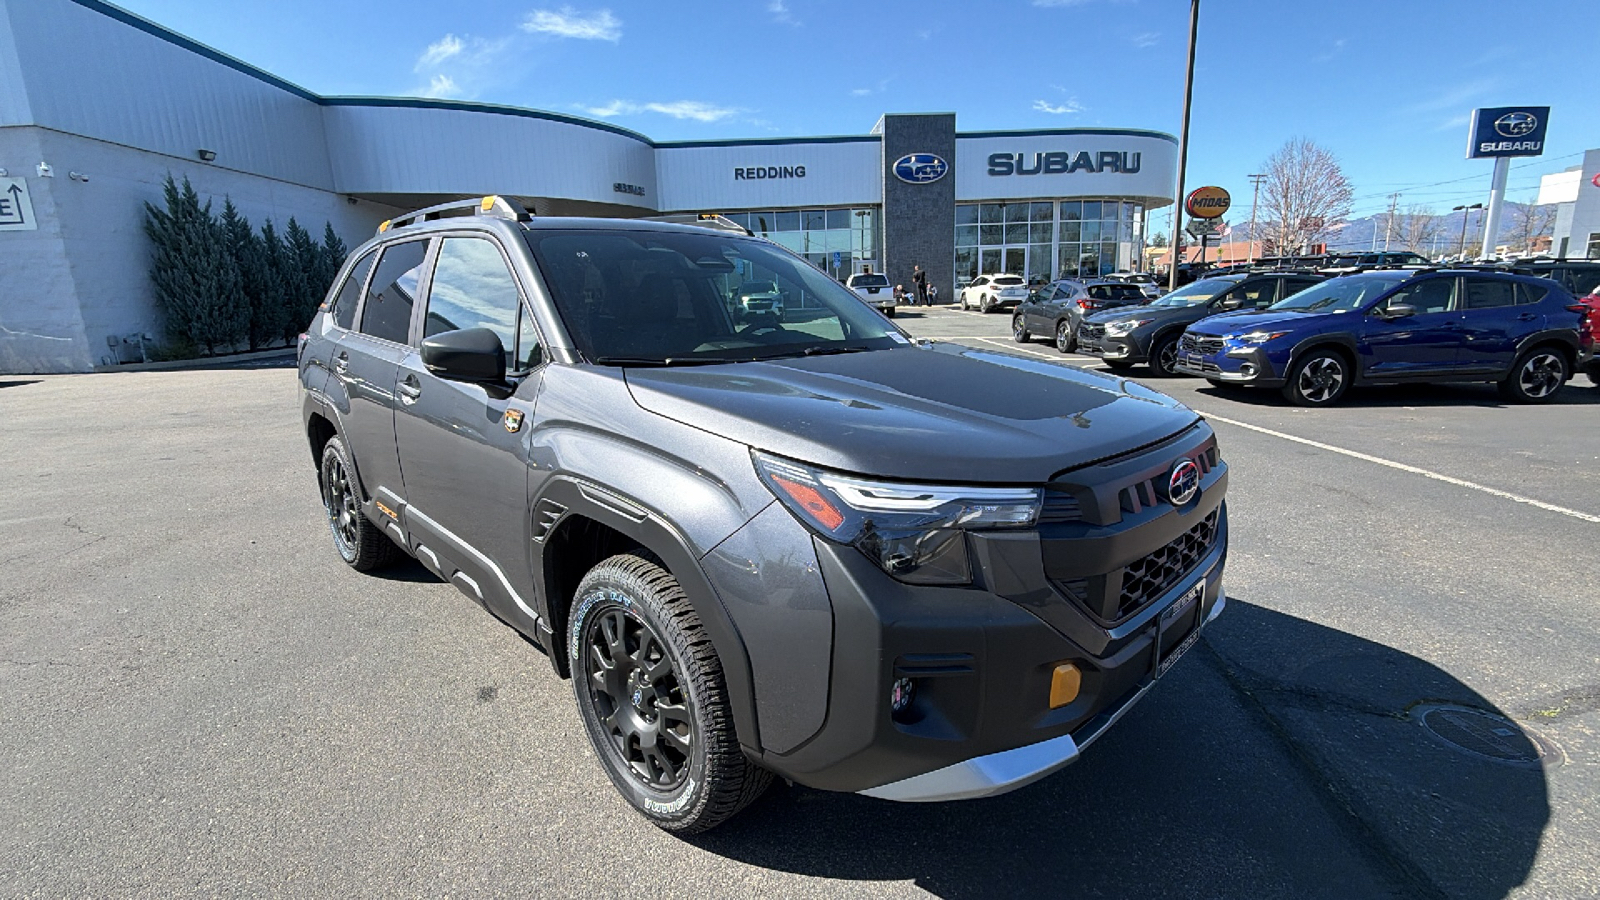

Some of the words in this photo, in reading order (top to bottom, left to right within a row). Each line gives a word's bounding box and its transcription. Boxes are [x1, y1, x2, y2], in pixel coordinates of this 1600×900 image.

[1480, 141, 1541, 152] SUBARU
[987, 151, 1141, 176] SUBARU
[734, 166, 806, 180] REDDING
[1192, 195, 1229, 207] MIDAS
